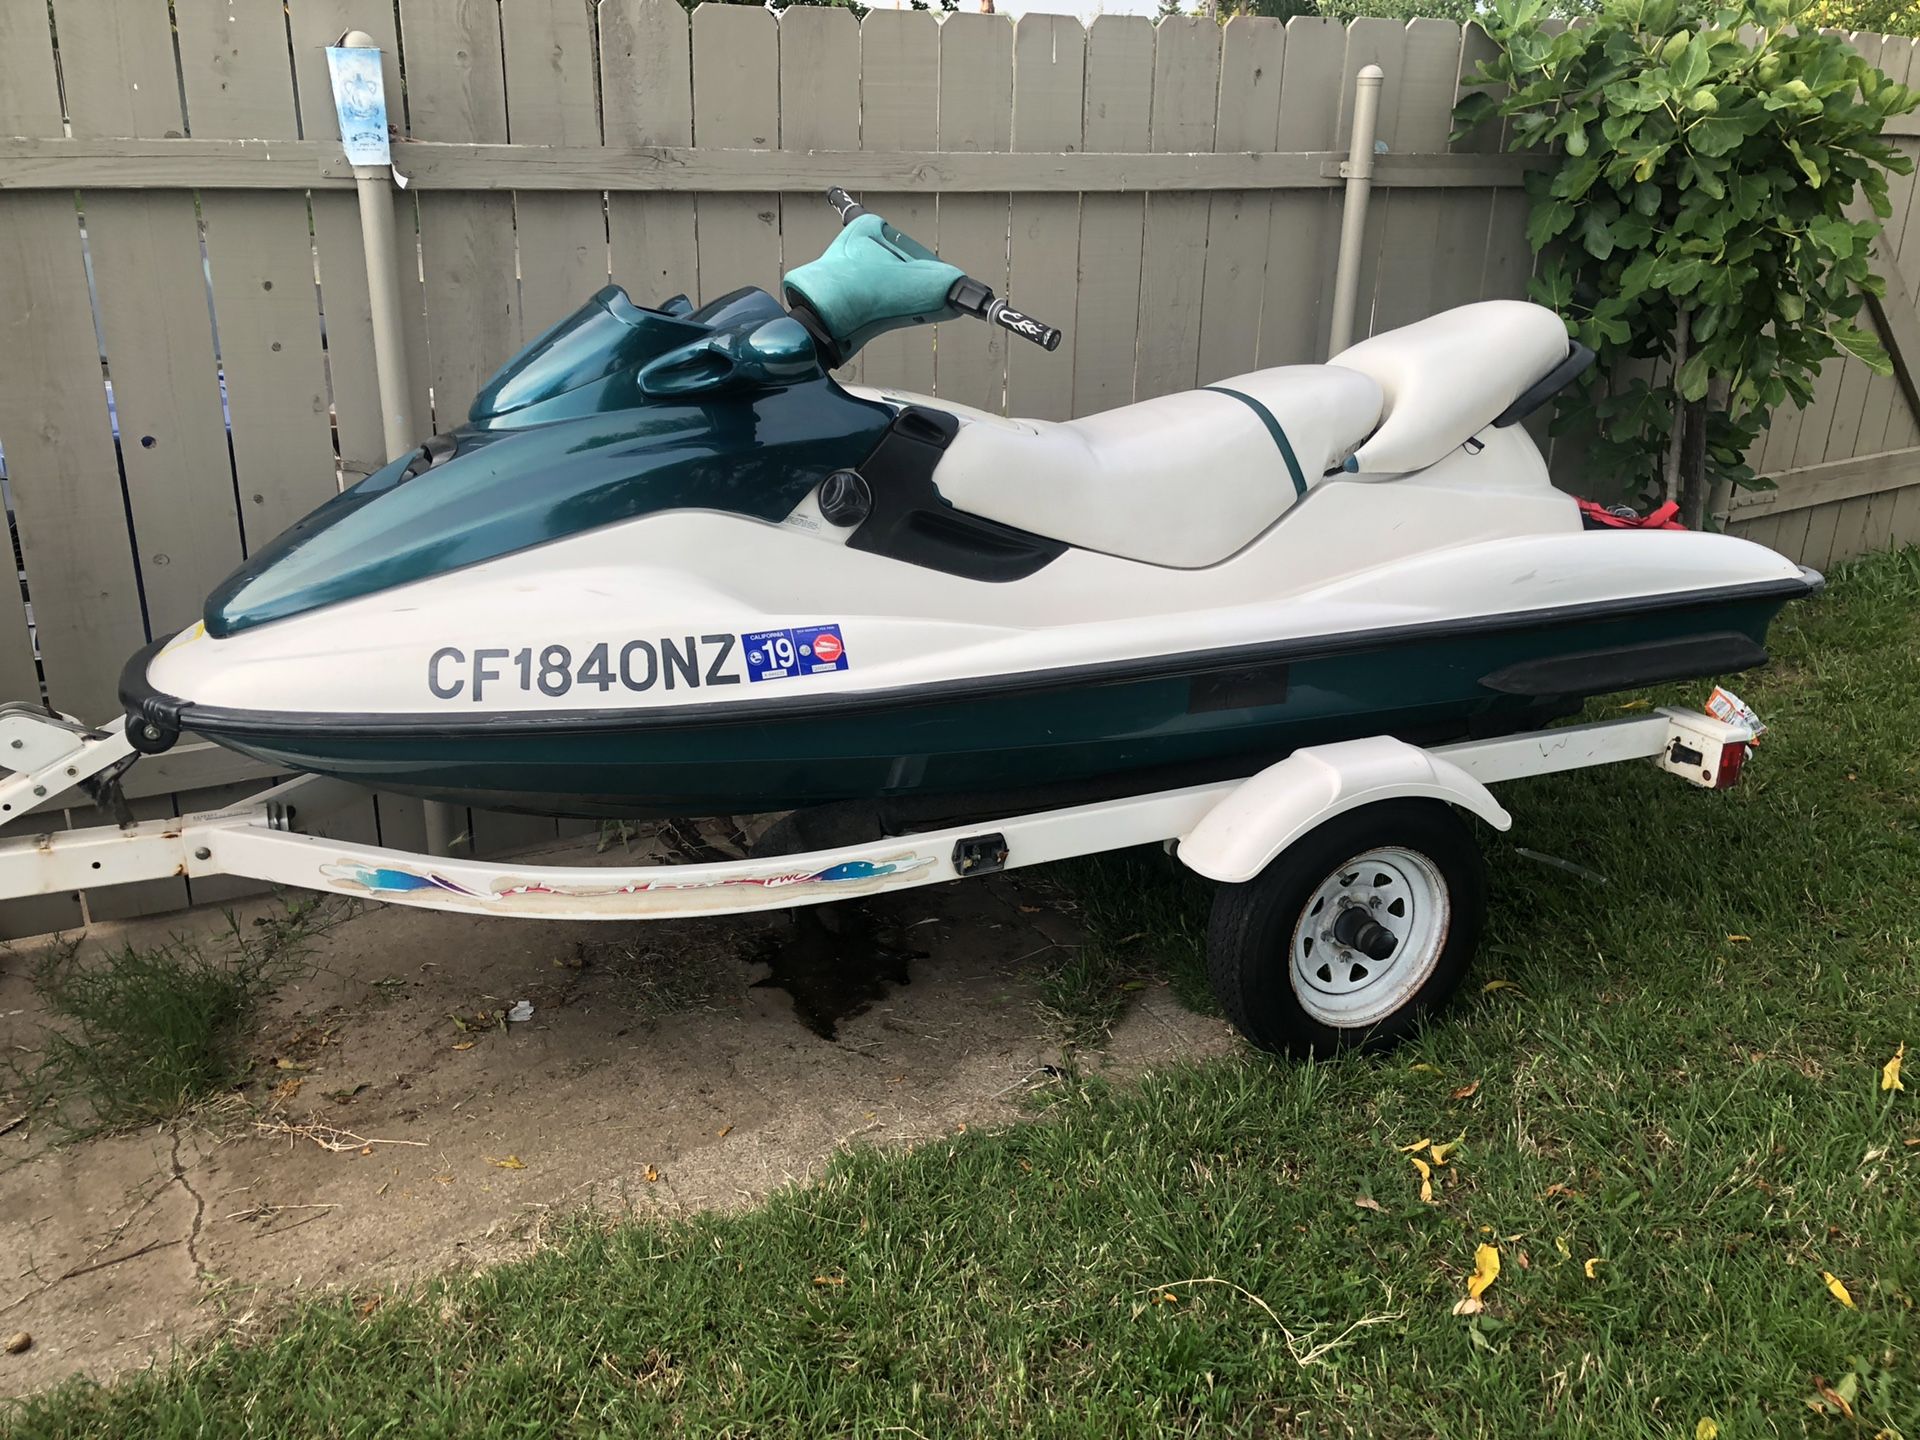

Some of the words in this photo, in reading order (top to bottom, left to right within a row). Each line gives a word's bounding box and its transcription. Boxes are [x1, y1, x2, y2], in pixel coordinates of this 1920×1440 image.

[750, 632, 785, 641] CALIFORNIA
[428, 633, 741, 702] CF1840NZ
[762, 638, 795, 669] 19
